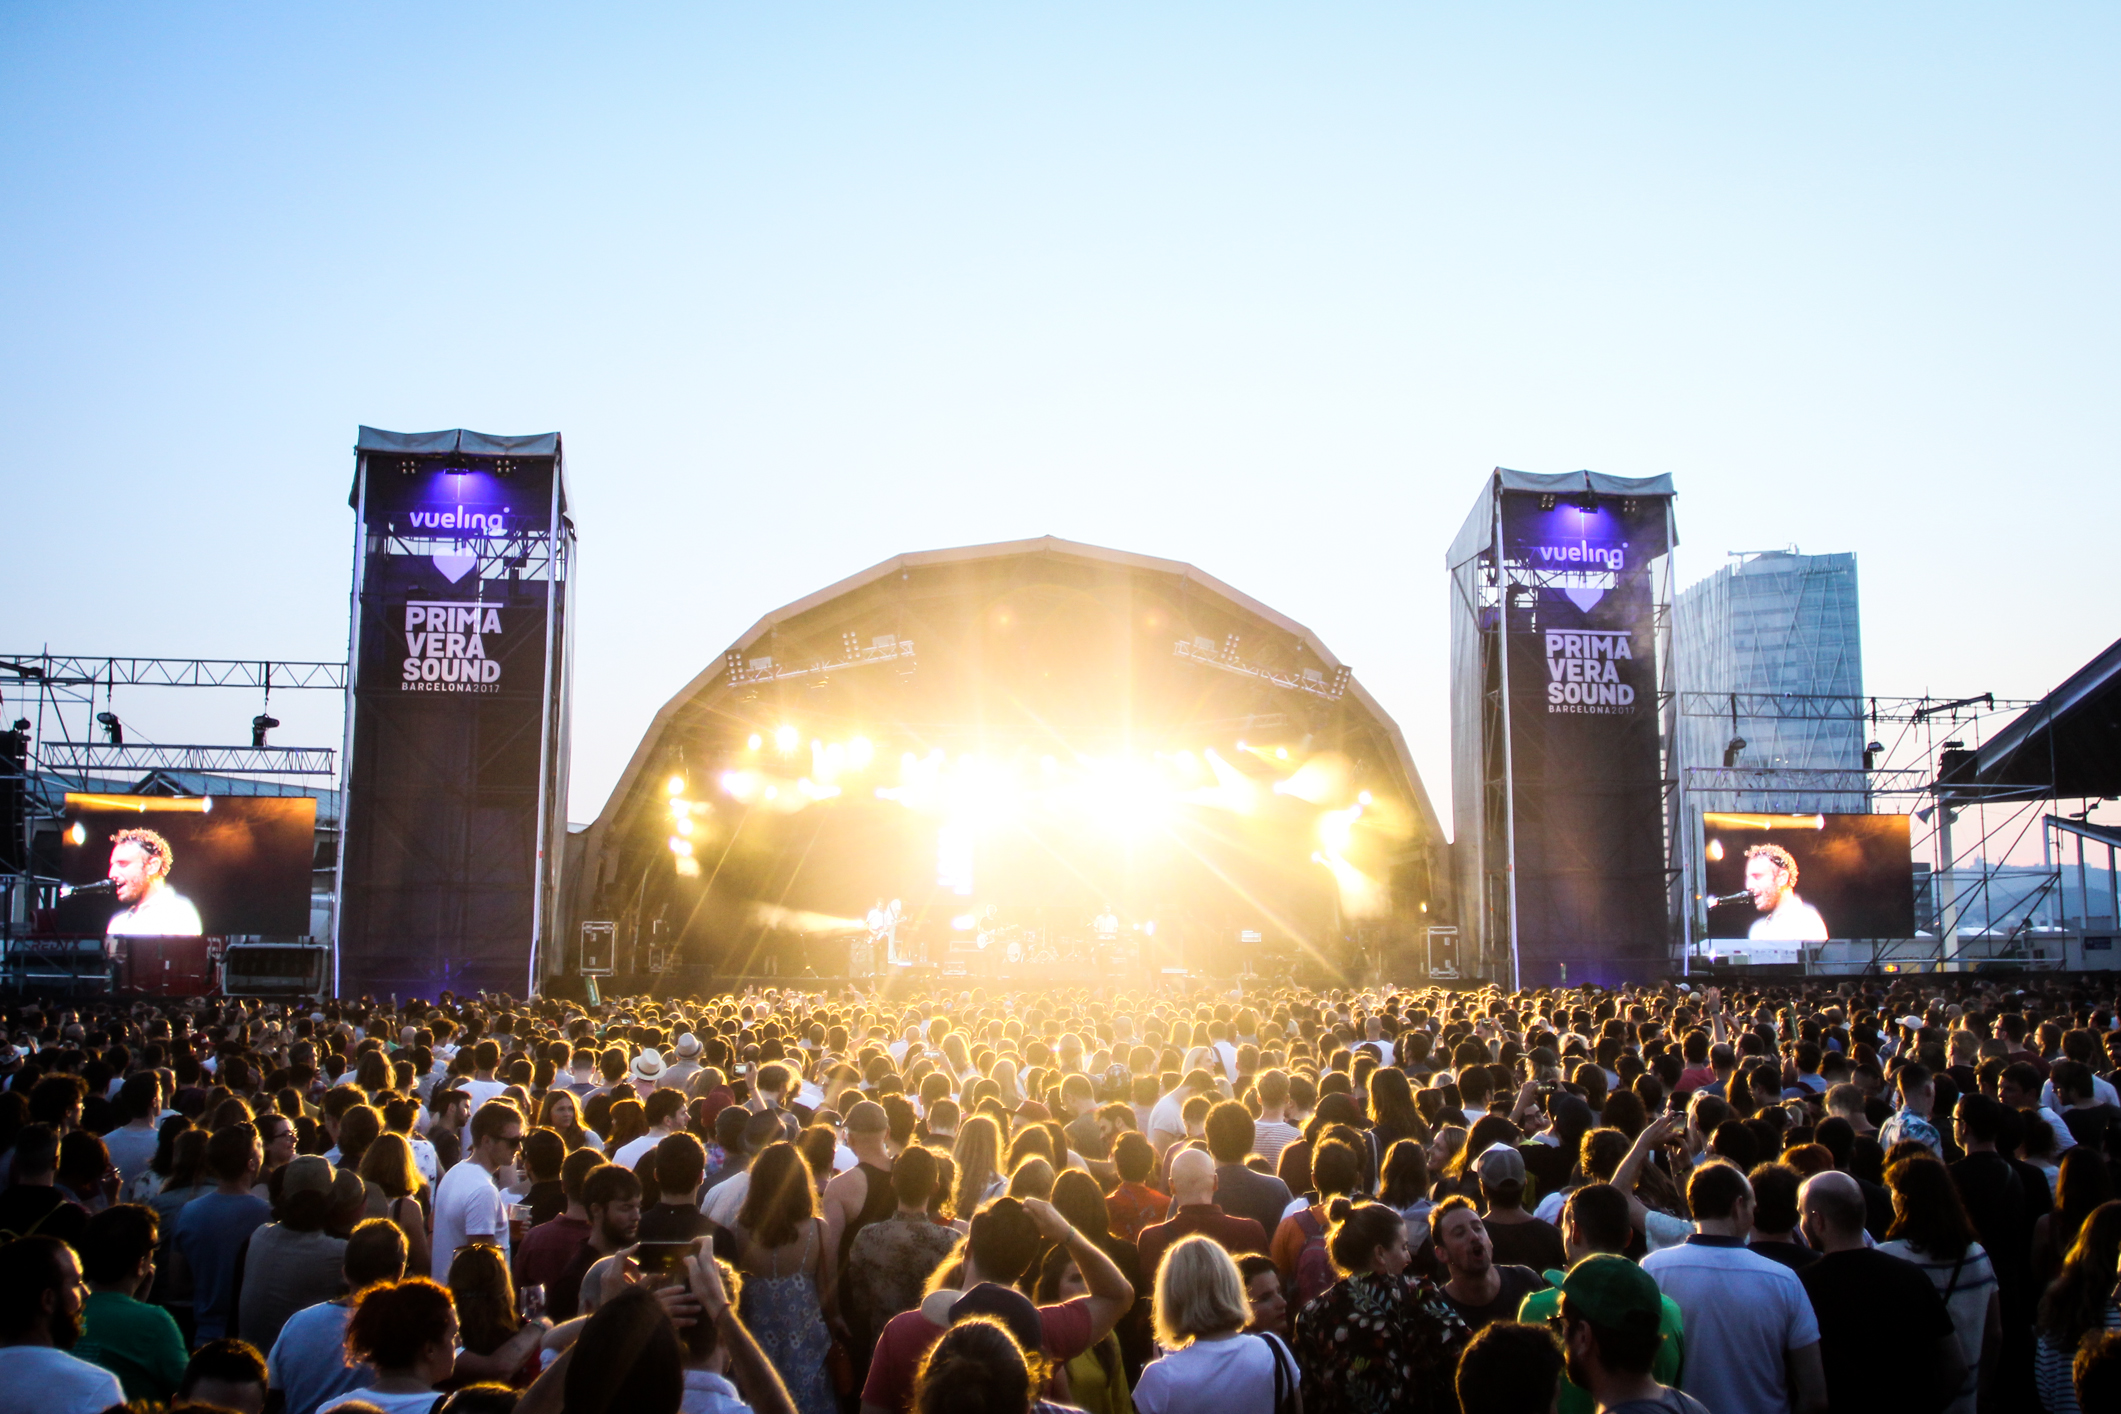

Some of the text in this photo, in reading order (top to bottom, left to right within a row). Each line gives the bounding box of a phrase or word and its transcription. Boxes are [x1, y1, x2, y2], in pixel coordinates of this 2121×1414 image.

[409, 504, 506, 537] vueling
[1540, 540, 1624, 570] vueling
[405, 607, 502, 634] PRIMA
[405, 632, 486, 660] VERA
[1546, 634, 1632, 660] PRIMA
[402, 657, 501, 684] SOUND
[1547, 658, 1620, 683] VERA
[1548, 682, 1635, 706] SOUND
